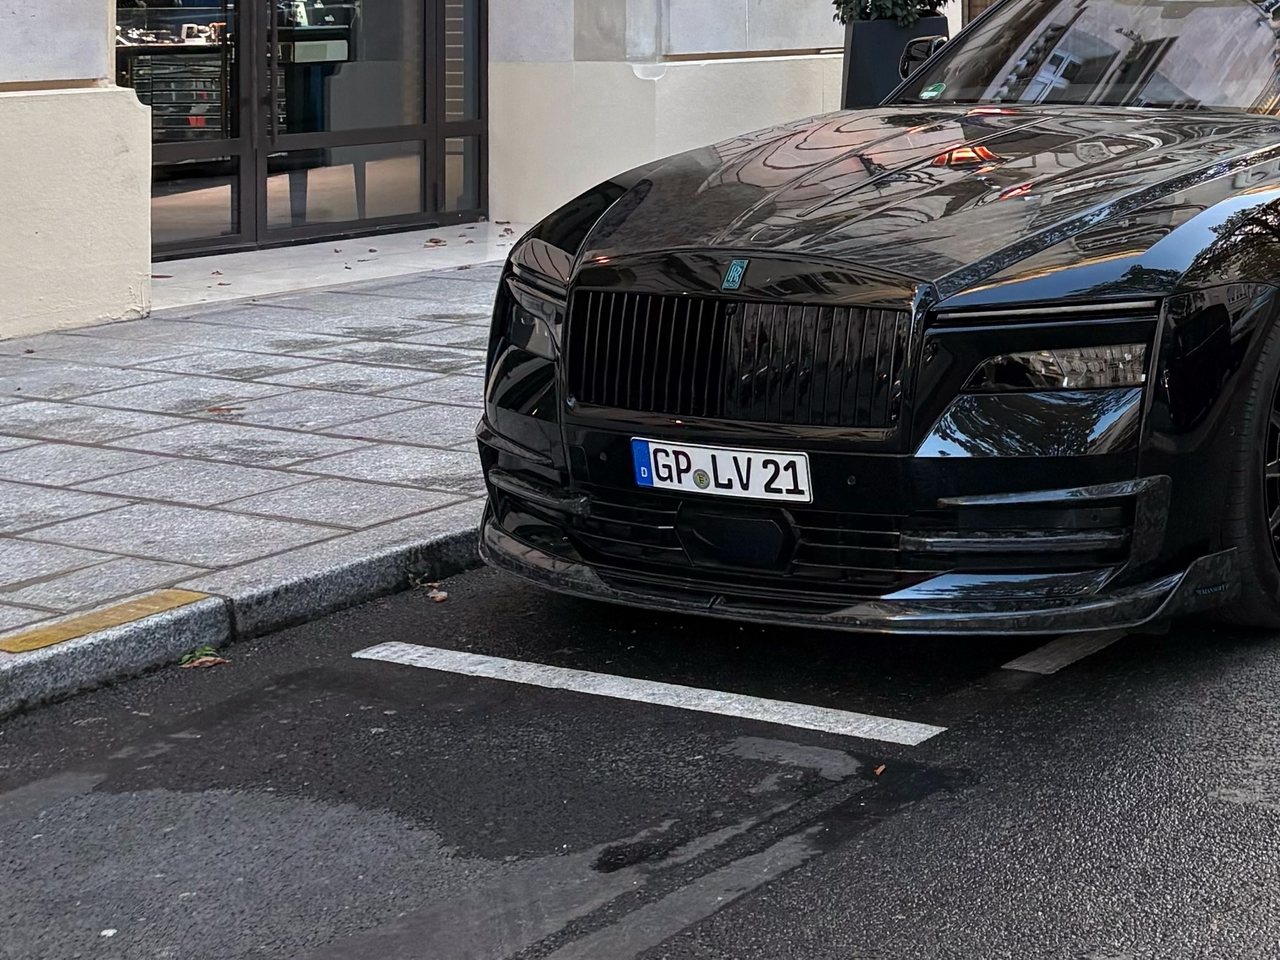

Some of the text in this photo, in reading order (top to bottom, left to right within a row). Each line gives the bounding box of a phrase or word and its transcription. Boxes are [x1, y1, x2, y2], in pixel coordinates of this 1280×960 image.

[641, 467, 648, 477] D
[652, 448, 805, 495] GP LV 21
